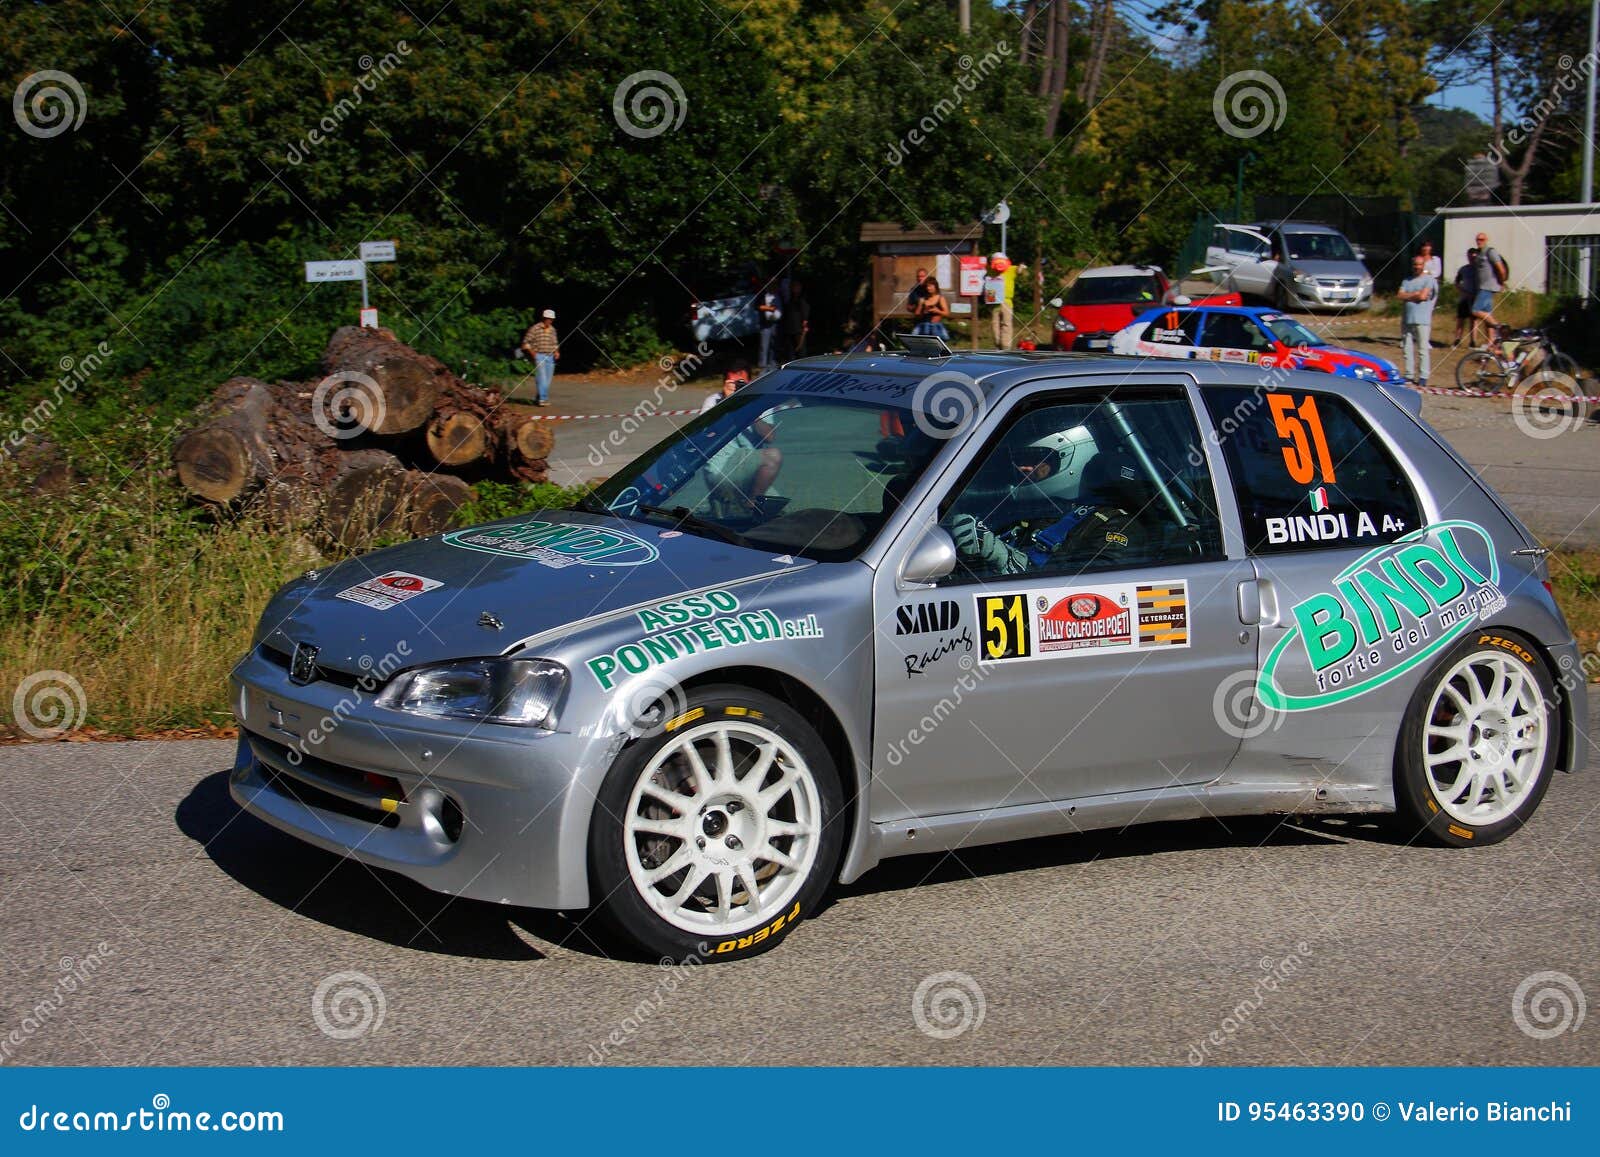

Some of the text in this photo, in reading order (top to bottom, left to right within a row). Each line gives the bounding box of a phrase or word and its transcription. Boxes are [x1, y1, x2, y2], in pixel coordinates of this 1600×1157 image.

[1266, 393, 1336, 484] 51
[477, 521, 645, 562] BINDI
[1265, 513, 1349, 544] BINDI
[1356, 511, 1378, 537] A
[636, 590, 739, 634] ASSO
[896, 601, 960, 636] SMD
[1151, 613, 1184, 622] TERRAZZE
[1291, 527, 1489, 674] BINDI
[586, 609, 781, 690] PONTEGGI
[986, 596, 1026, 658] 51
[1040, 612, 1129, 640] RALLY GOLFO DEI POETI
[904, 626, 973, 679] Racing
[1317, 652, 1381, 693] forte
[1392, 620, 1429, 652] dei
